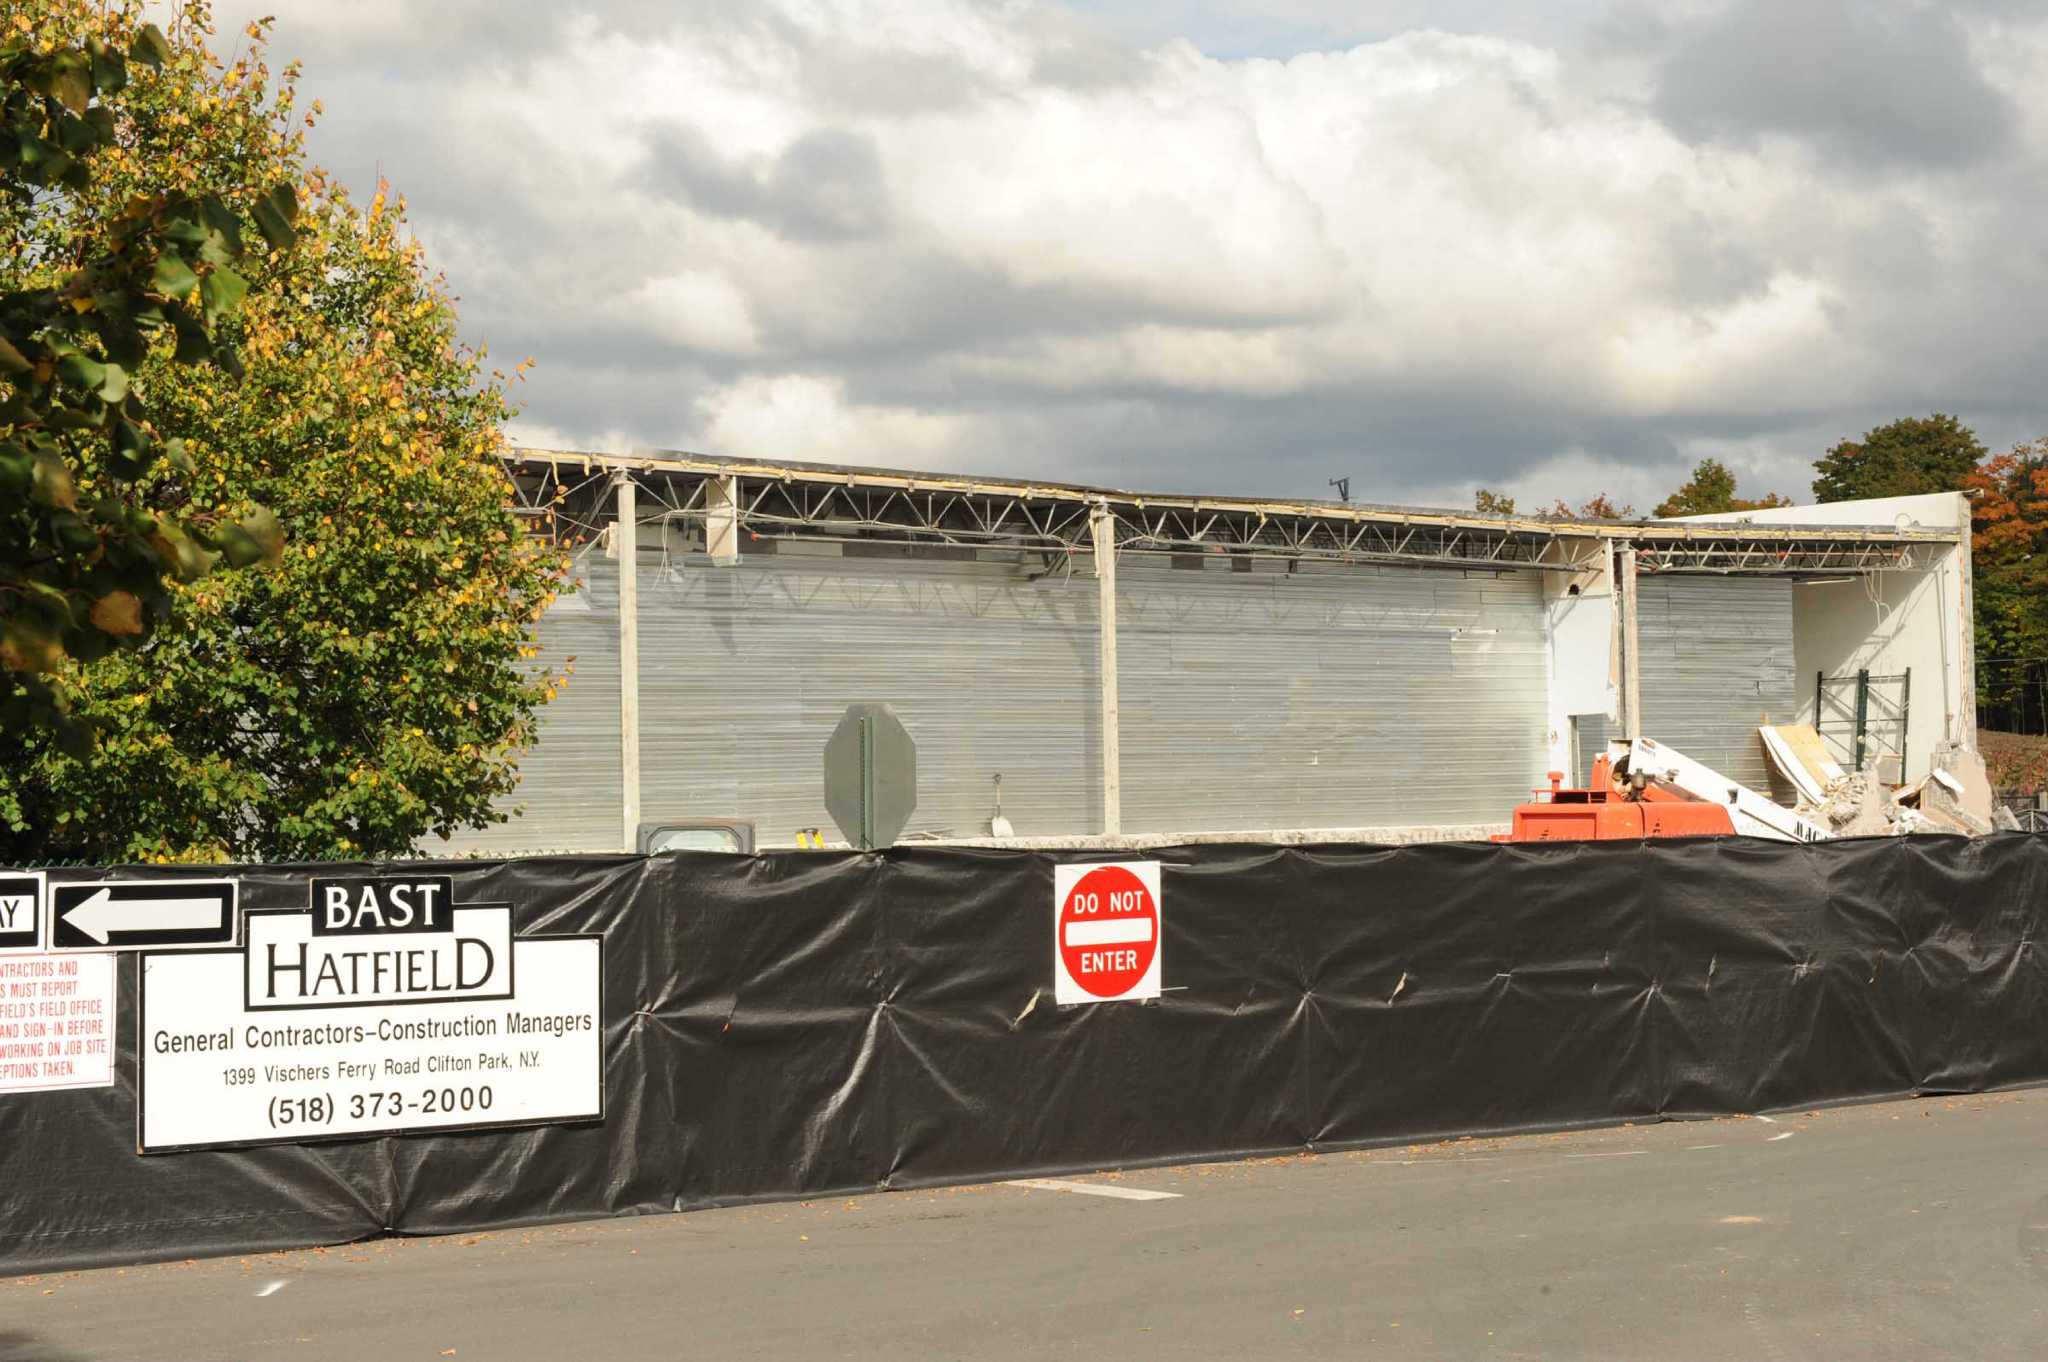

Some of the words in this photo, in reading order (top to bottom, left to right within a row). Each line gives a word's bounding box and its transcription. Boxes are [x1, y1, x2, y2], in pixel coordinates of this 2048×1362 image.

[0, 899, 20, 929] Y
[325, 884, 441, 929] BAST
[1074, 893, 1099, 914] DO
[1110, 890, 1144, 913] NOT
[58, 960, 79, 976] AND
[266, 938, 495, 998] HATFIELD
[1081, 950, 1137, 974] ENTER
[10, 982, 38, 998] MUST
[41, 980, 78, 997] REPORT
[39, 1000, 67, 1017] FIELD
[69, 999, 103, 1016] OFFICE
[0, 1023, 19, 1038] AND
[23, 1021, 64, 1038] SIGN-IN
[67, 1019, 104, 1036] BEFORE
[154, 1027, 234, 1054] General
[506, 1012, 593, 1038] Managers
[47, 1041, 61, 1057] ON
[63, 1040, 82, 1056] JOB
[86, 1038, 107, 1055] SITE
[42, 1060, 76, 1077] TAKEN.
[222, 1066, 256, 1086] 1399
[264, 1064, 330, 1083] Vischers
[337, 1060, 377, 1081] Ferry
[384, 1057, 420, 1076] Road
[427, 1054, 472, 1073] Clifton
[478, 1051, 513, 1071] Park,
[519, 1050, 541, 1068] N.Y.
[268, 1092, 334, 1129] (518)
[349, 1085, 493, 1120] 373-2000
